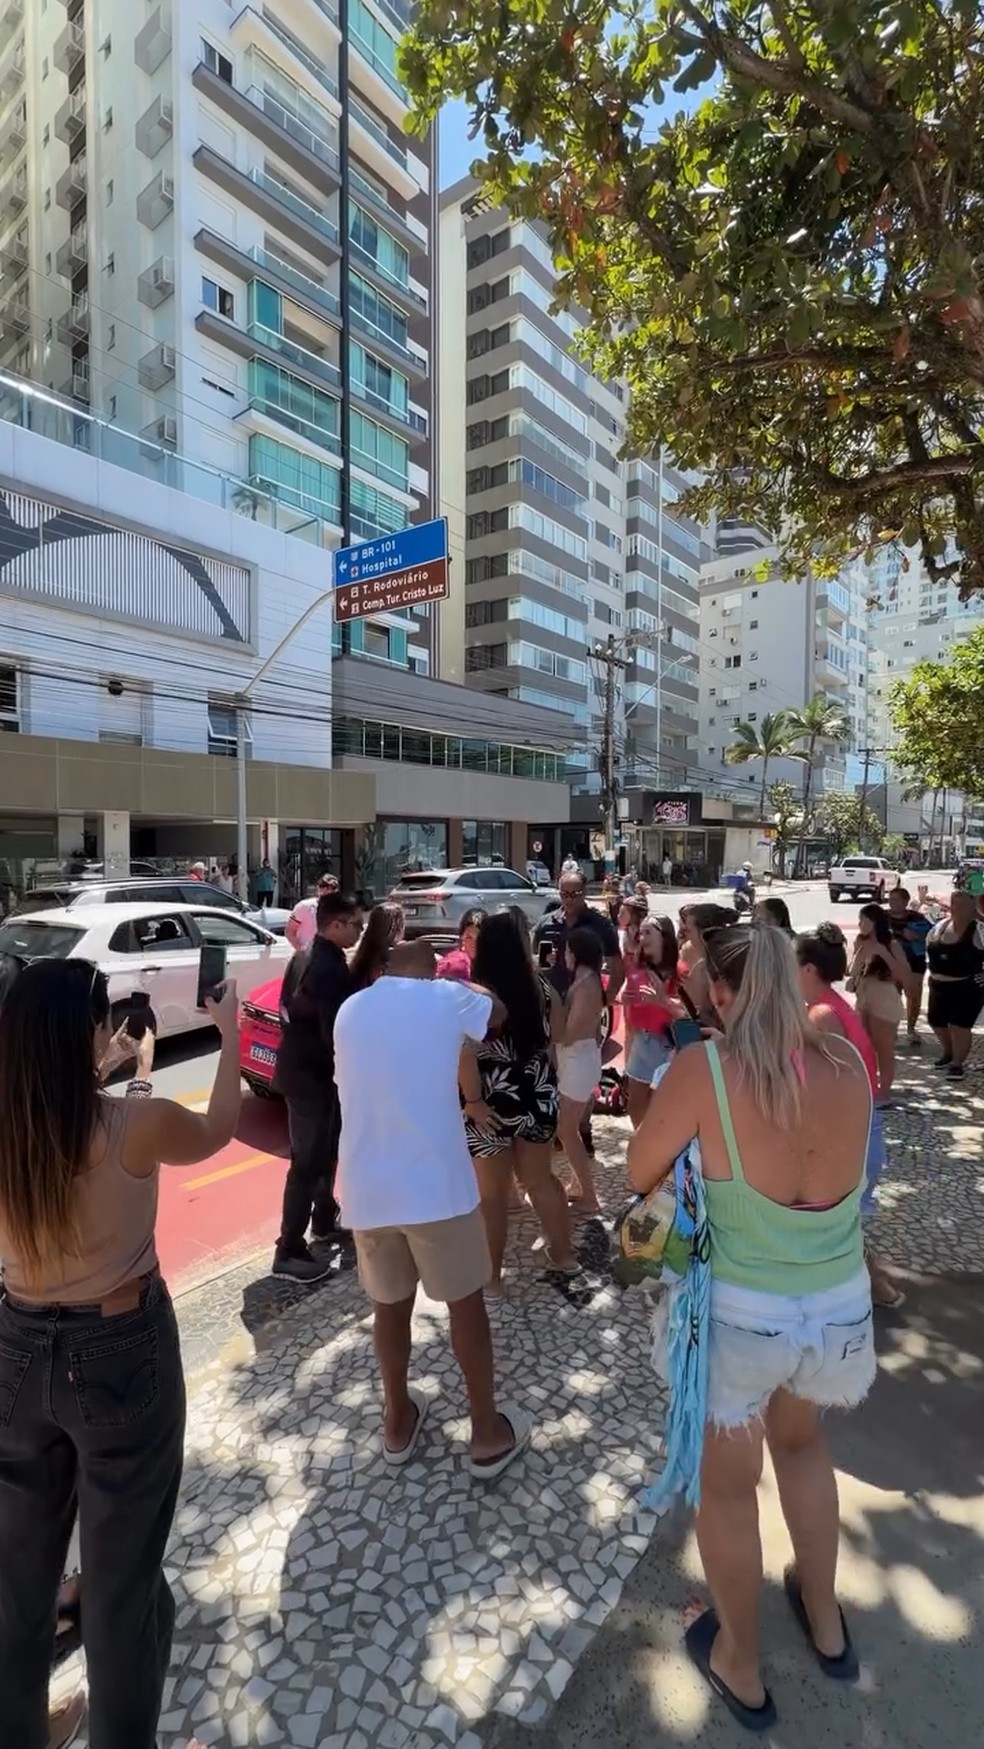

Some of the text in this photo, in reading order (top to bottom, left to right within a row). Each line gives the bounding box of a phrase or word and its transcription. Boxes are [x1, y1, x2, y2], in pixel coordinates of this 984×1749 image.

[362, 554, 402, 574] Hospital
[363, 571, 428, 594] T. Rodoviário
[386, 594, 401, 605] Tur.
[402, 588, 427, 601] Cristo
[428, 583, 444, 595] Luz
